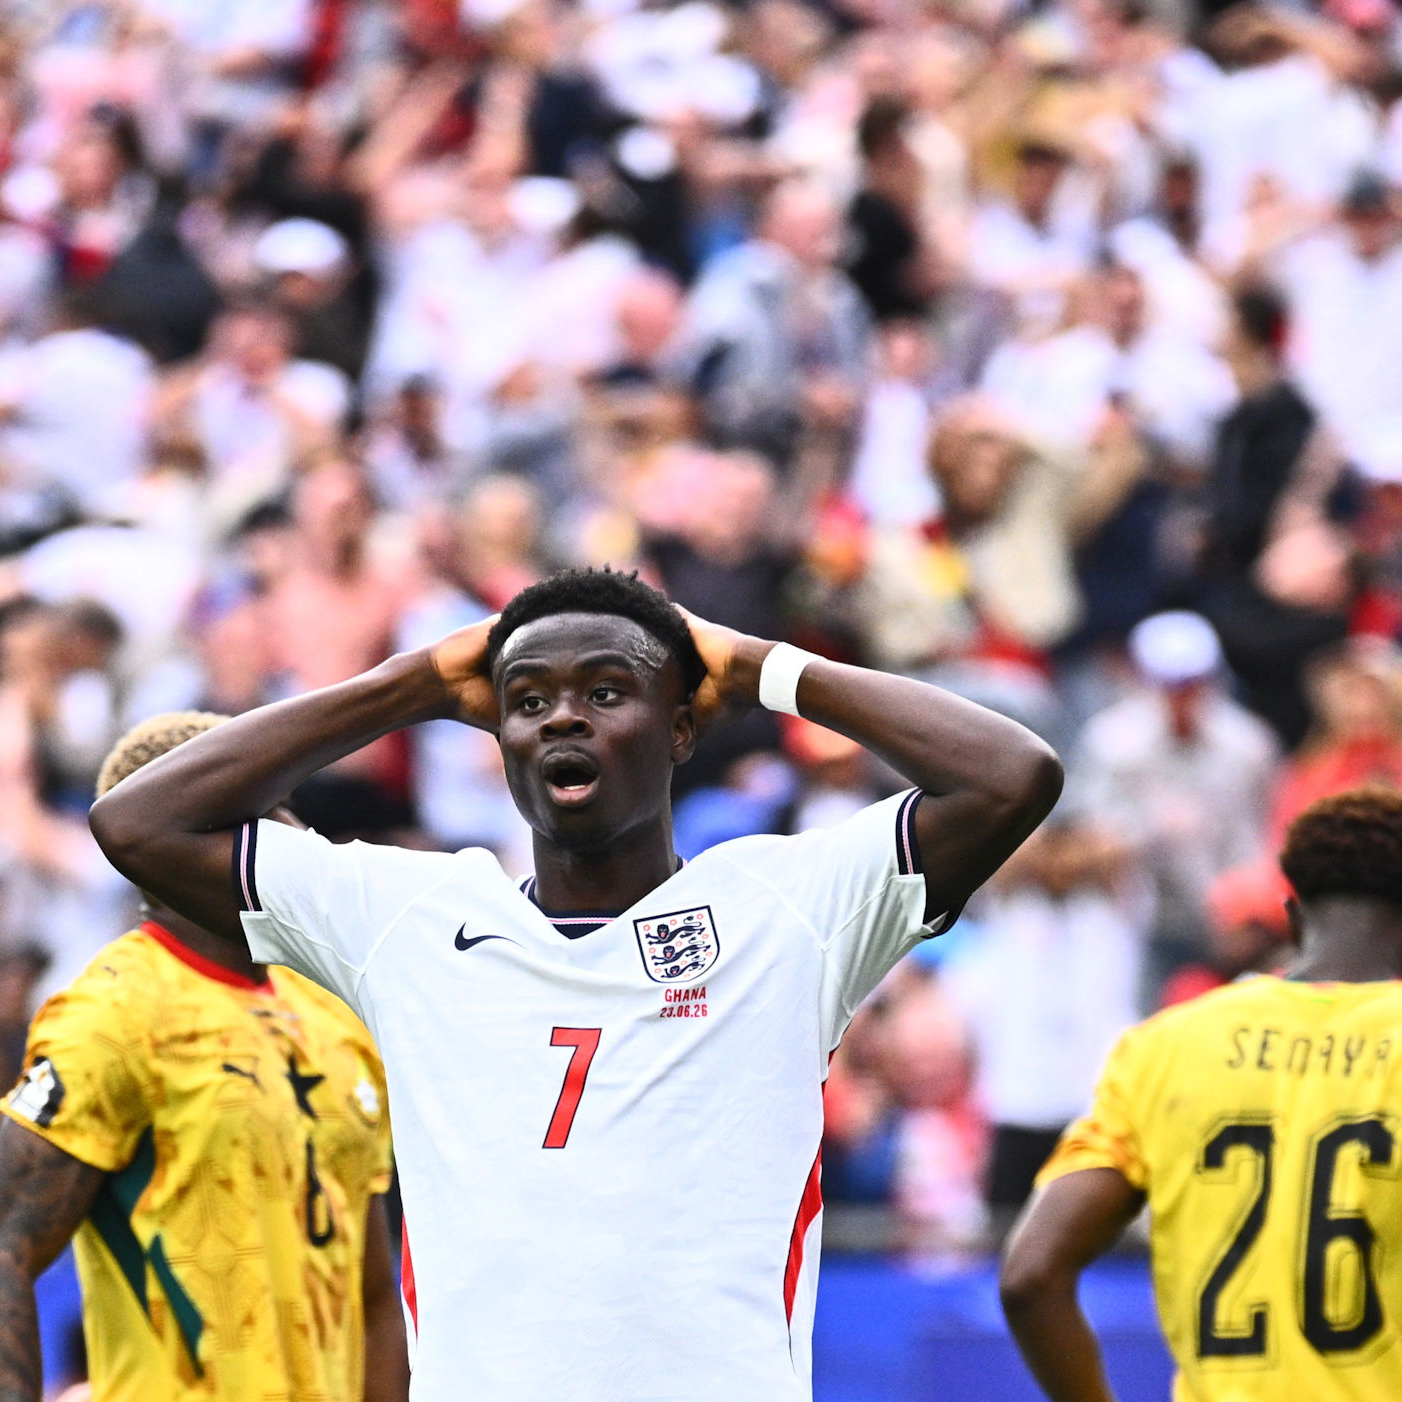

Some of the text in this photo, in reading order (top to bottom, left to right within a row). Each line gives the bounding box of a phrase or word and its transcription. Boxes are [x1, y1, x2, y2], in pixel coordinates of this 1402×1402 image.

[664, 986, 706, 1002] GHANA
[659, 1004, 708, 1018] 23.06.26
[542, 1026, 602, 1149] 7
